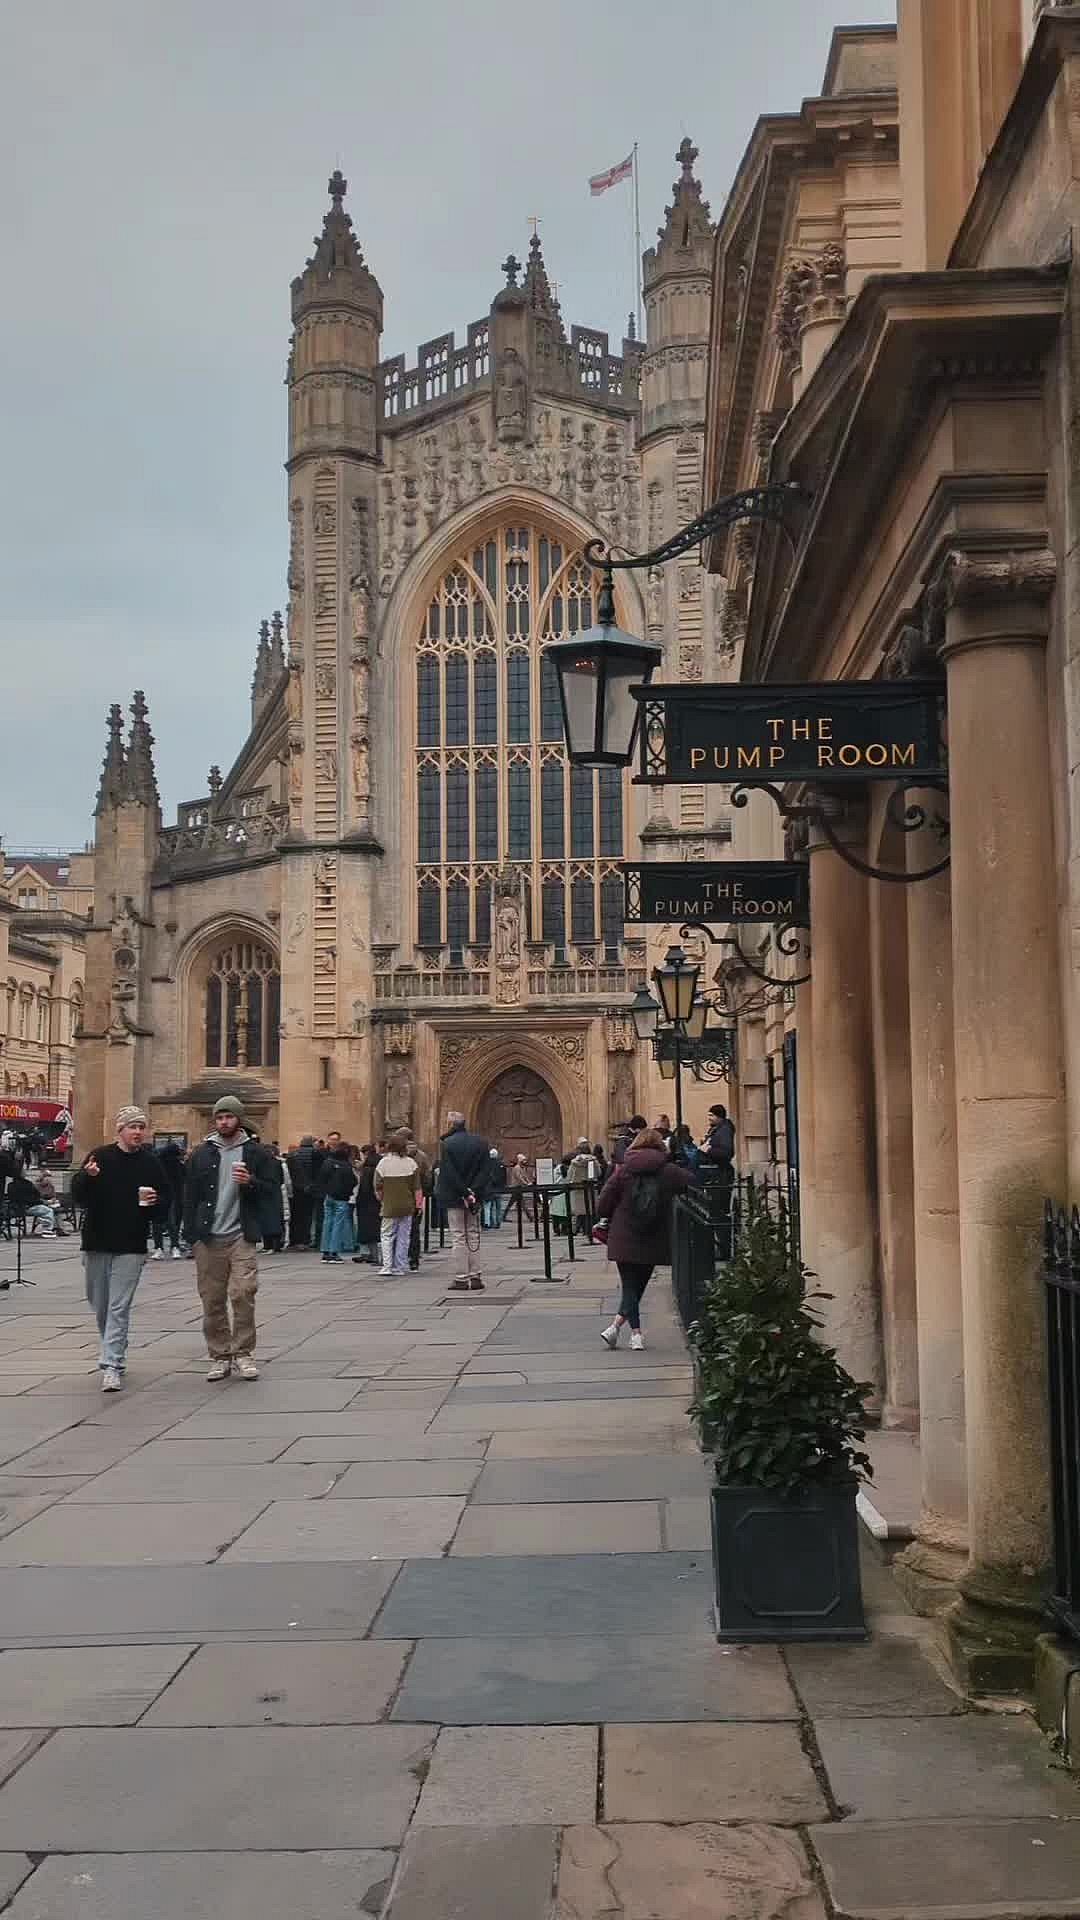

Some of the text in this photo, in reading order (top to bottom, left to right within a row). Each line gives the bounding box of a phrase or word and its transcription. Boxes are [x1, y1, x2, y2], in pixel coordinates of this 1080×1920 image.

[766, 718, 833, 741] THE
[689, 743, 915, 769] PUMP ROOM
[701, 883, 743, 898] THE
[655, 900, 793, 915] PUMP ROOM
